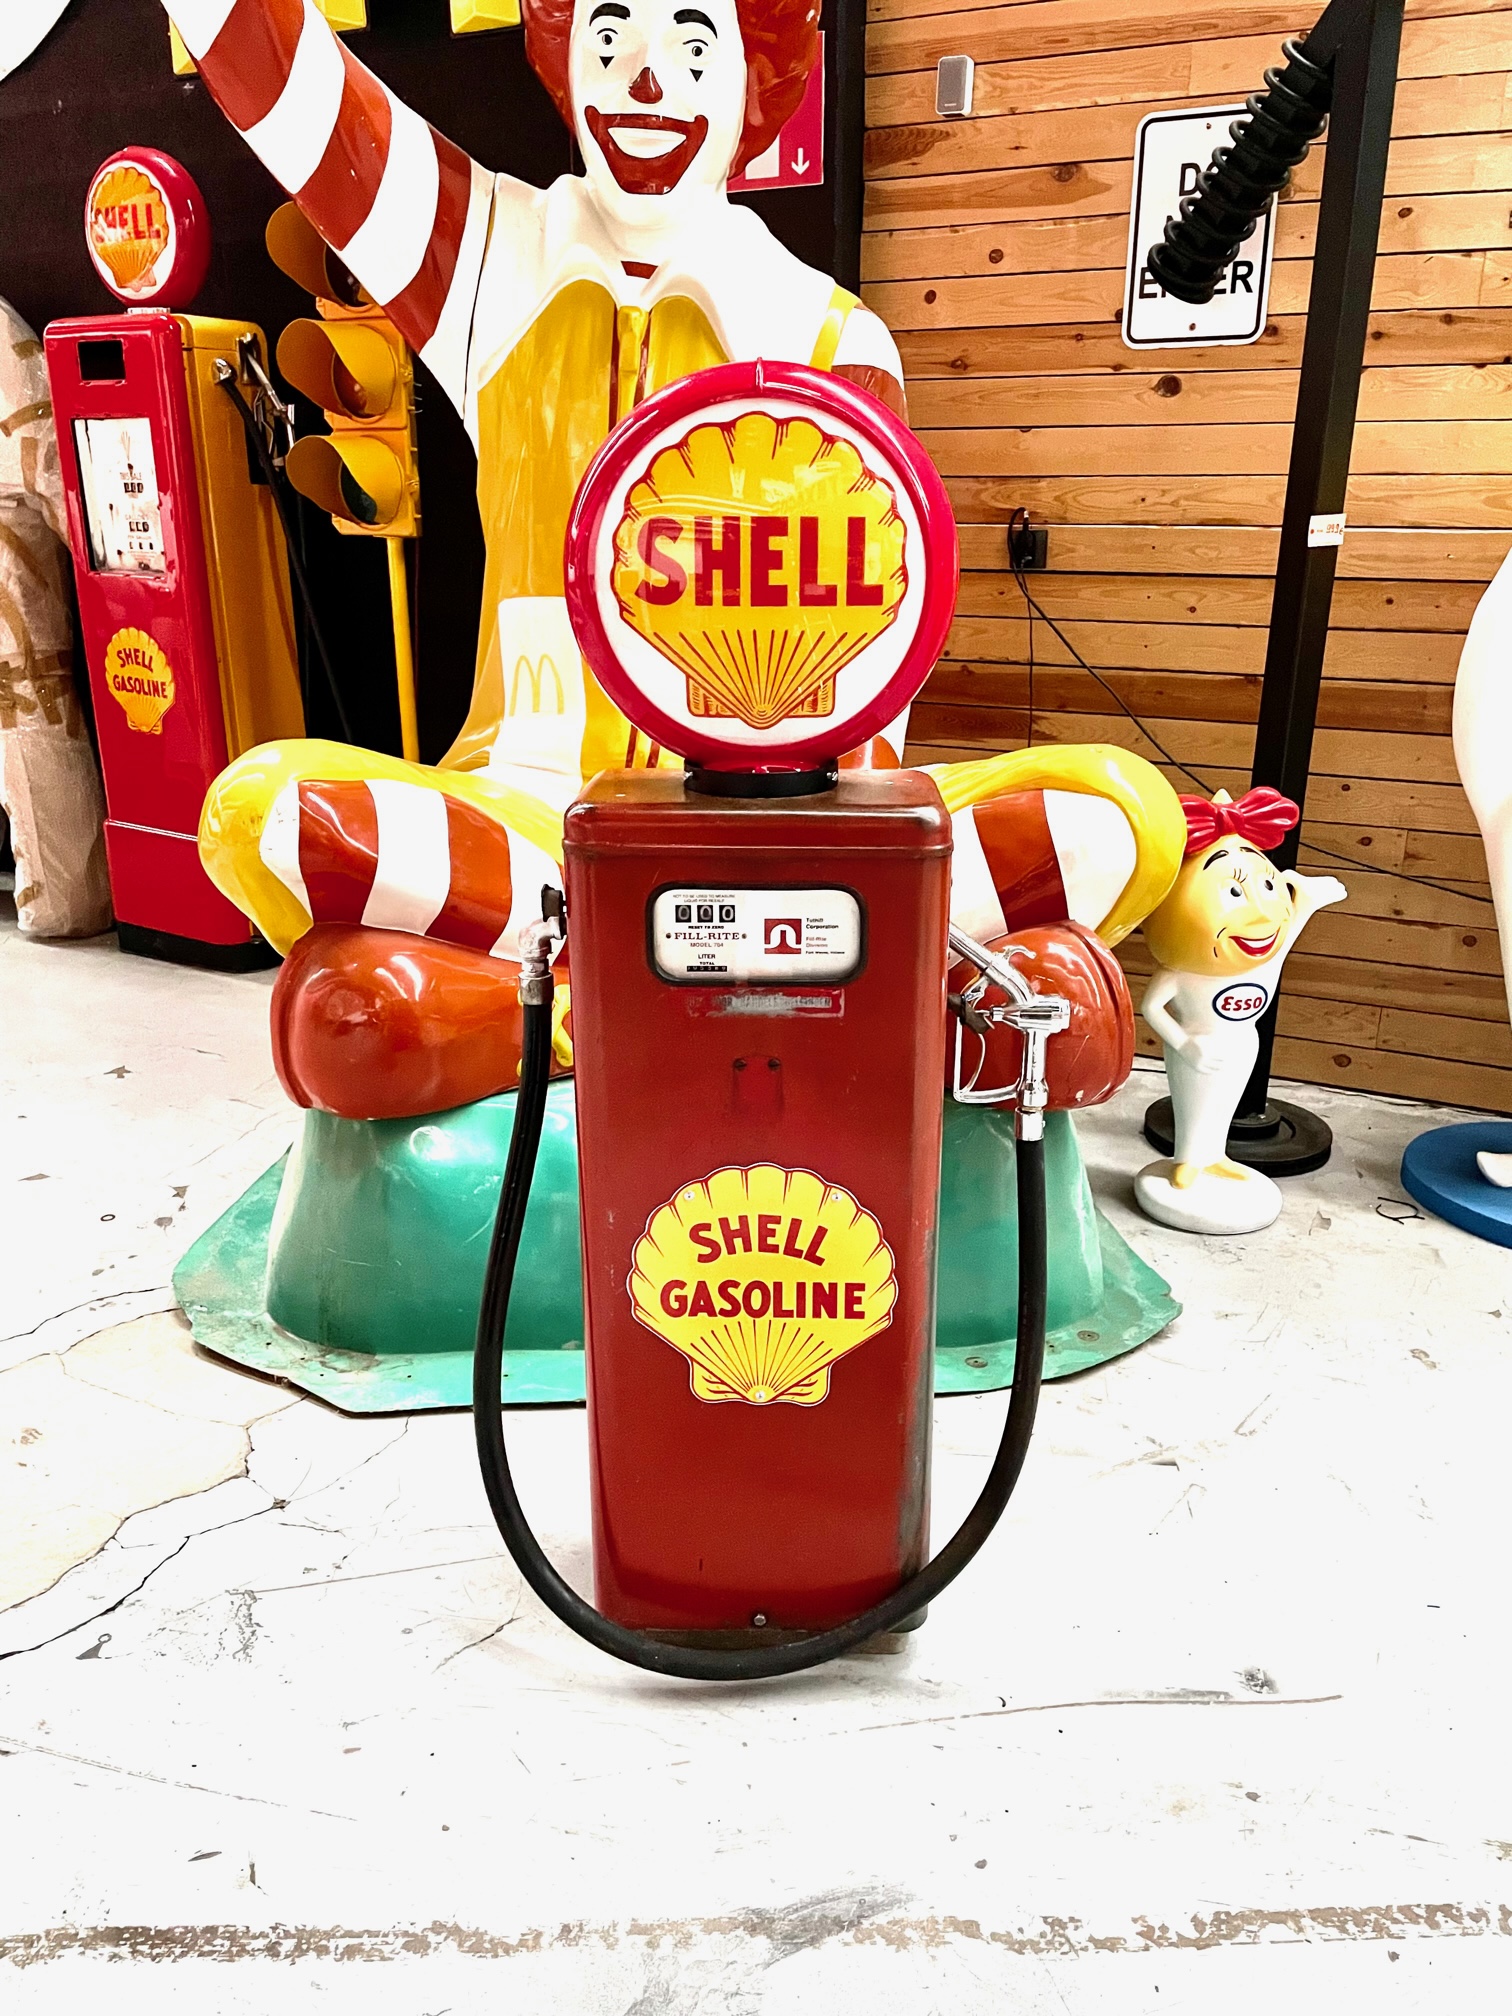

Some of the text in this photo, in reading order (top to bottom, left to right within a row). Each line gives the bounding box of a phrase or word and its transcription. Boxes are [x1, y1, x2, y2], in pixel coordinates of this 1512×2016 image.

[93, 203, 162, 244] SHELL
[635, 515, 885, 607] SHELL
[116, 647, 153, 673] SHELL
[112, 674, 168, 699] GASOLINE
[674, 932, 740, 940] FILL-RITE
[1221, 996, 1263, 1012] Esso
[688, 1213, 829, 1267] SHELL
[659, 1279, 866, 1320] GASOLINE
